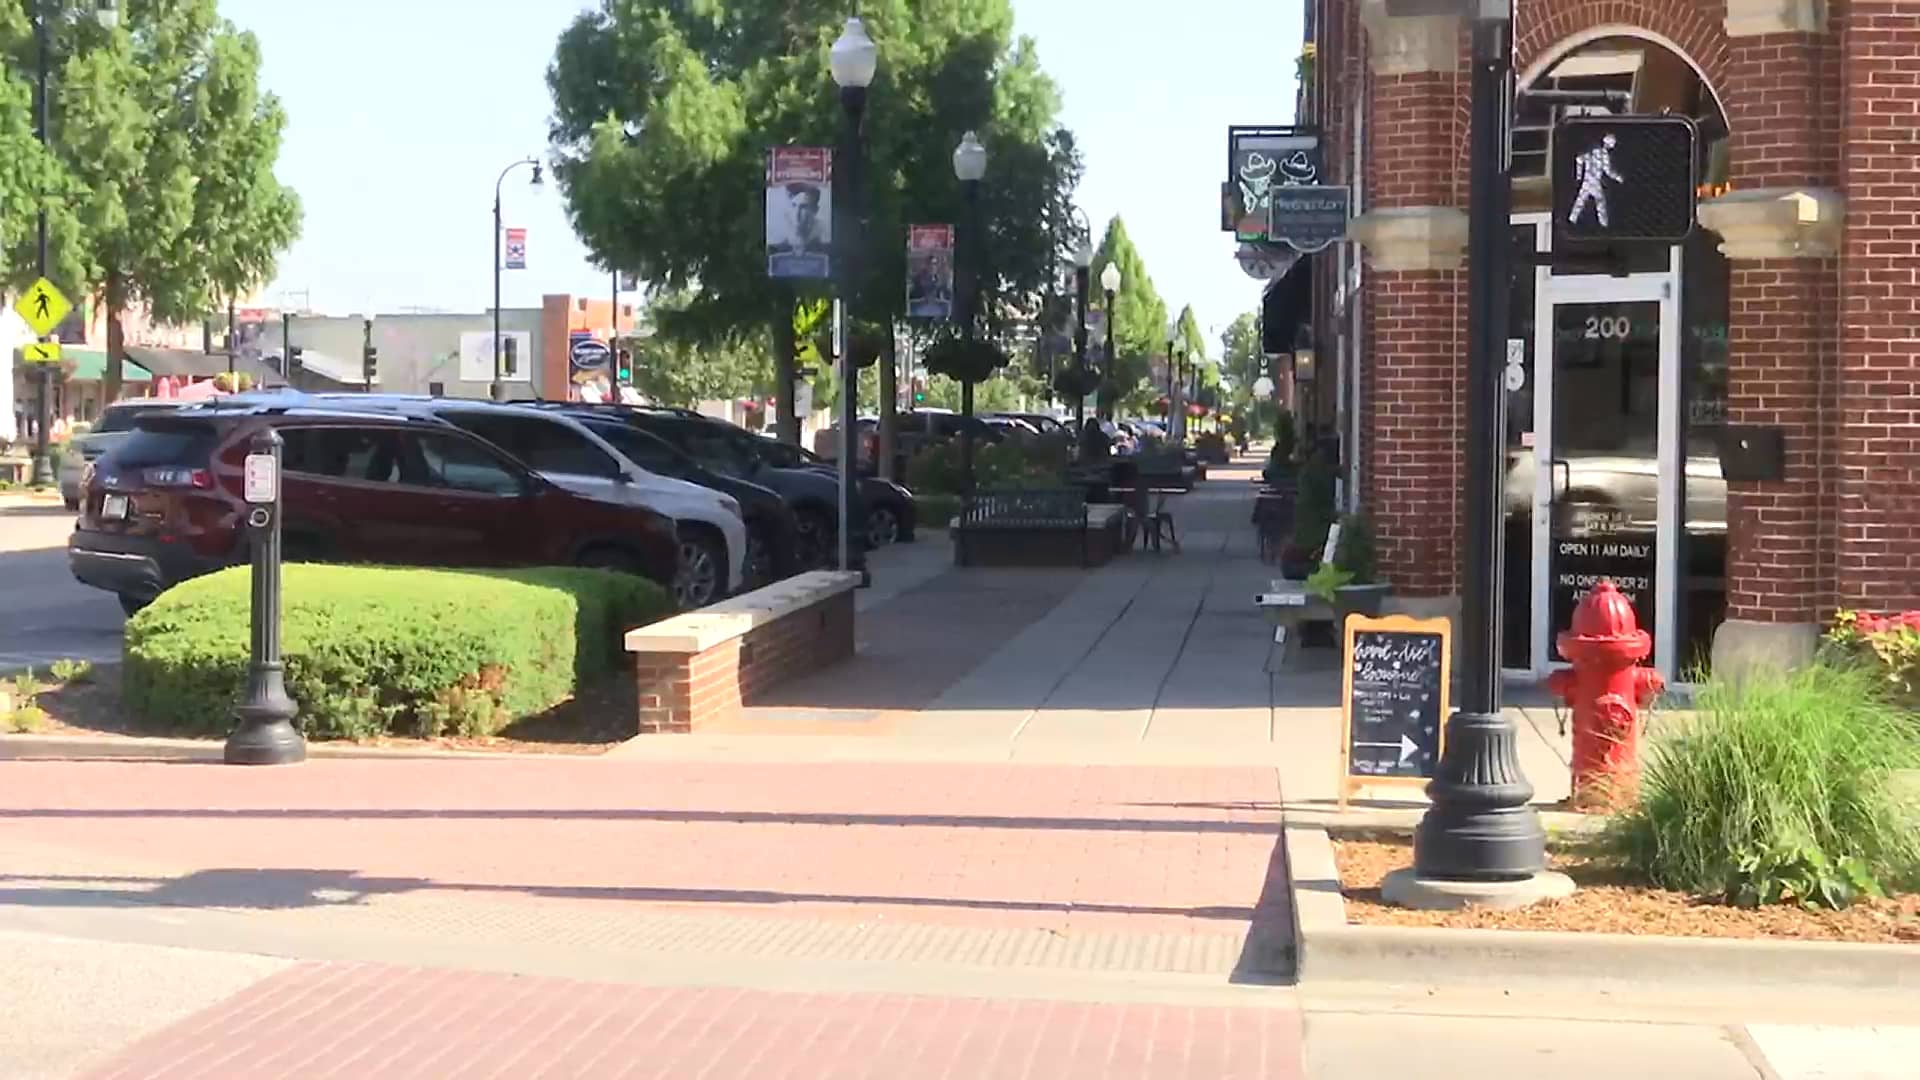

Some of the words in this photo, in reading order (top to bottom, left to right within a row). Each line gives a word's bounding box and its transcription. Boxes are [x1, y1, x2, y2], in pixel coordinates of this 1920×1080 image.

[1584, 316, 1631, 338] 200
[1560, 543, 1588, 555] OPEN
[1590, 544, 1599, 555] 11
[1602, 545, 1618, 556] AM
[1620, 545, 1650, 558] DAILY
[1560, 574, 1575, 586] NO
[1638, 578, 1649, 589] 21
